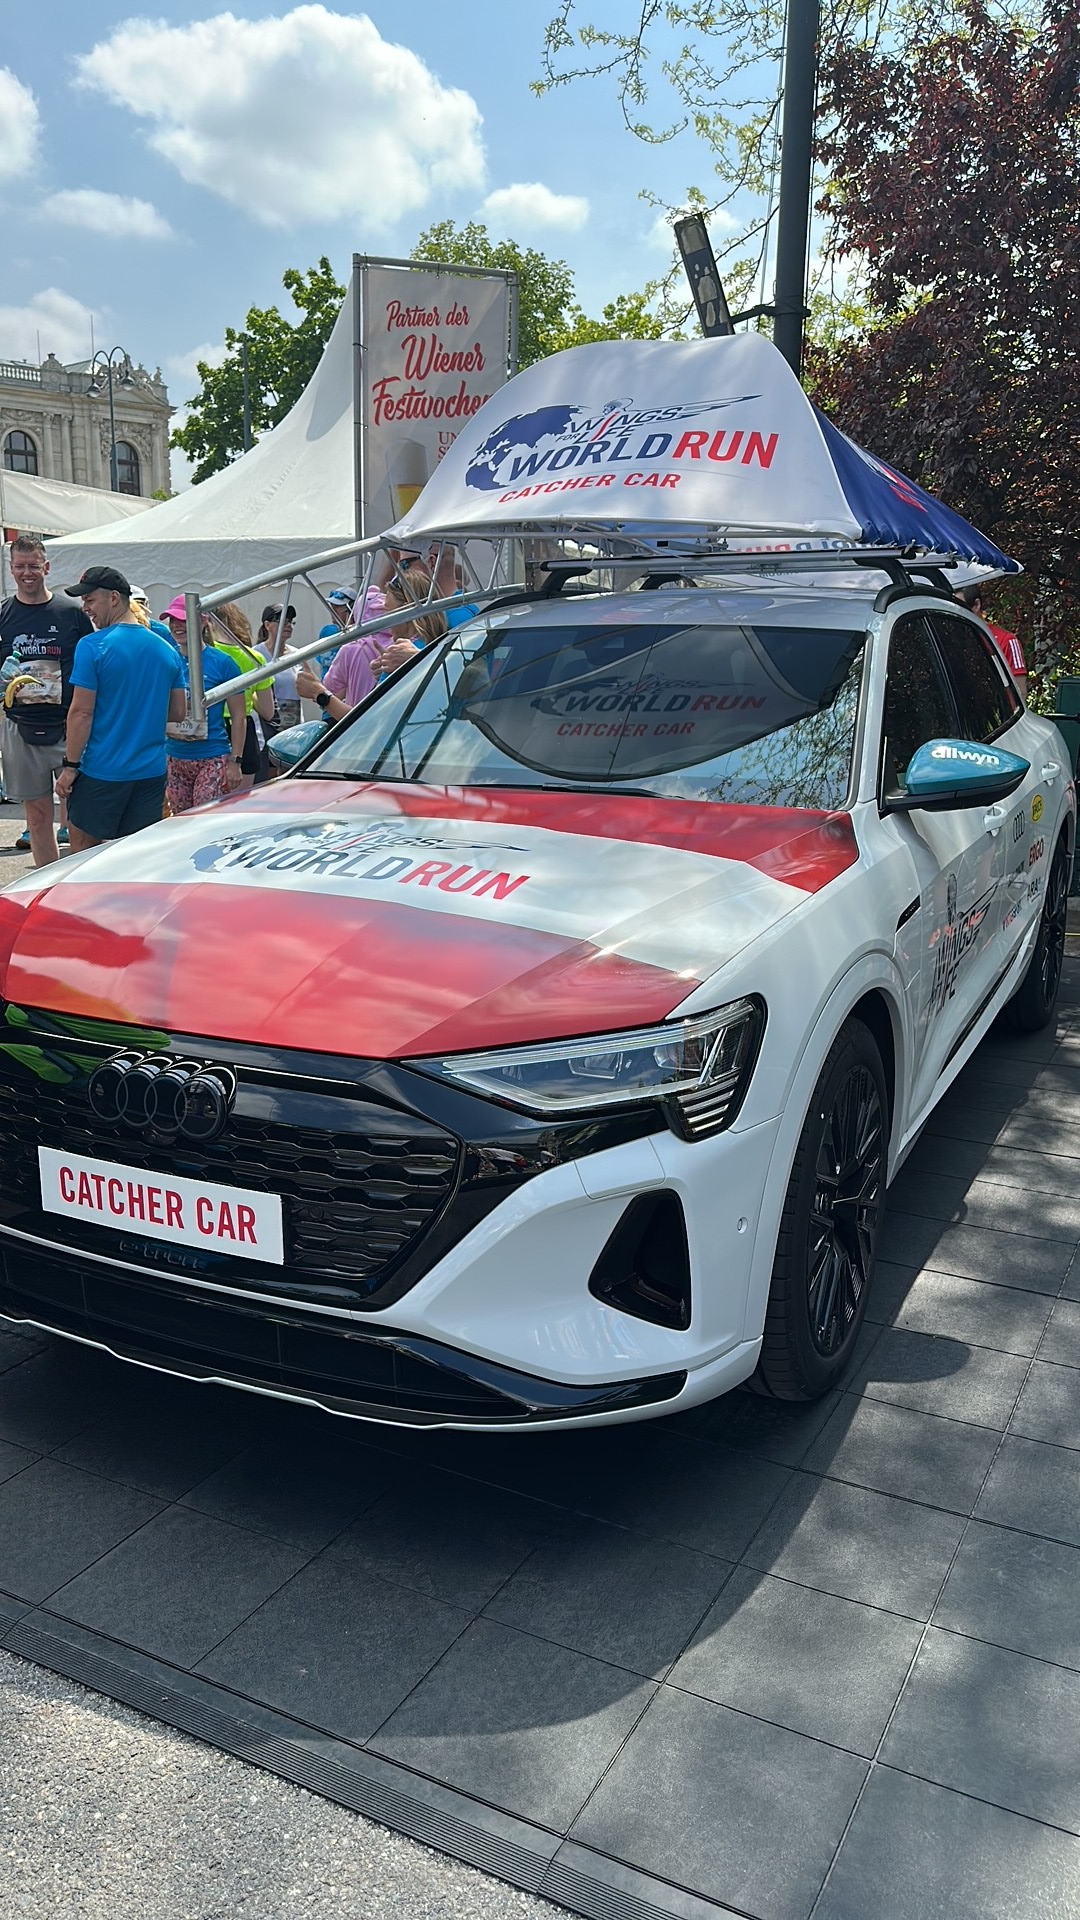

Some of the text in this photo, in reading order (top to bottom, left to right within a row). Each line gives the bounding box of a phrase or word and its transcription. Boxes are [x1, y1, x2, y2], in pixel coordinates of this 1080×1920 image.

[386, 300, 470, 331] Partner der
[401, 333, 486, 380] Wiener
[571, 407, 683, 434] WINGS
[573, 423, 643, 444] LIFE
[509, 430, 779, 481] WORLD RUN
[499, 473, 682, 503] CATCHER CAR
[20, 646, 47, 655] WORLD
[565, 694, 767, 712] WORLD RUN
[557, 721, 696, 738] CATCHER CAR
[931, 745, 1000, 765] allwyn
[322, 831, 445, 848] WINGS
[1028, 838, 1044, 867] ERGO
[225, 846, 531, 900] WORLD RUN
[59, 1166, 258, 1244] CATCHER CAR
